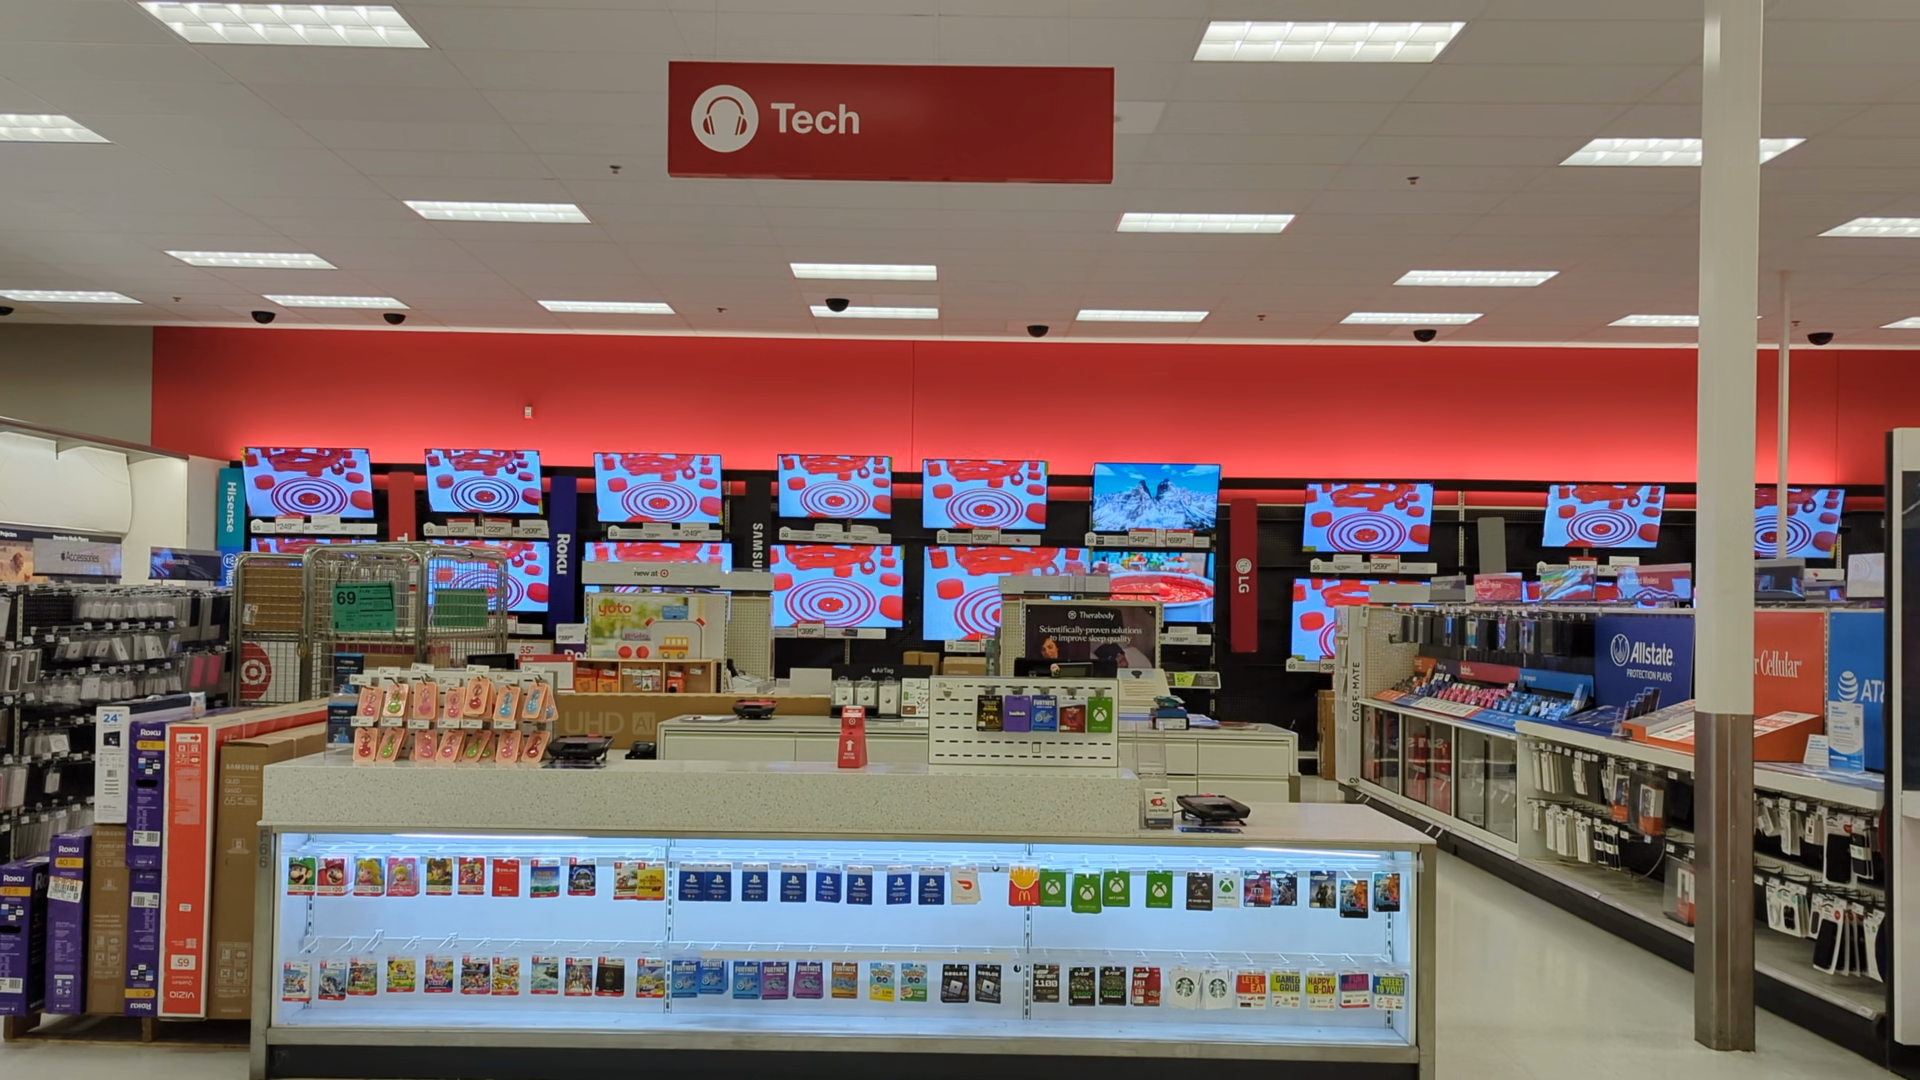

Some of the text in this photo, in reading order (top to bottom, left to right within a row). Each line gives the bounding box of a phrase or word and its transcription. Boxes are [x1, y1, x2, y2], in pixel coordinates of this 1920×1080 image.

[771, 103, 860, 134] Tech
[226, 482, 237, 533] Hisense
[752, 522, 763, 573] SAMSU
[66, 551, 99, 563] Accessories
[1238, 576, 1250, 594] LG
[336, 591, 356, 605] 69
[598, 602, 632, 617] yoto
[1079, 610, 1115, 621] Therabody
[1039, 625, 1110, 635] Scientifically-proven
[1058, 634, 1087, 644] improve
[1088, 635, 1106, 643] sleep
[1107, 635, 1132, 644] quality
[1630, 641, 1673, 667] Allstate
[1760, 650, 1799, 678] Cellular
[876, 667, 894, 675] AirTag
[1627, 668, 1673, 682] PROTECTION PLANS
[565, 711, 625, 735] UHD
[140, 728, 161, 737] Roku
[58, 845, 79, 853] Roku
[3, 874, 25, 882] Roku
[1242, 976, 1260, 984] LET'S
[1308, 977, 1331, 985] HAPPY
[1380, 978, 1403, 986] CHEERS
[1250, 984, 1265, 993] EAT
[1280, 983, 1300, 992] GRUB
[1313, 985, 1336, 994] B-DAY
[1376, 985, 1384, 993] TO
[169, 990, 195, 999] VIZIO
